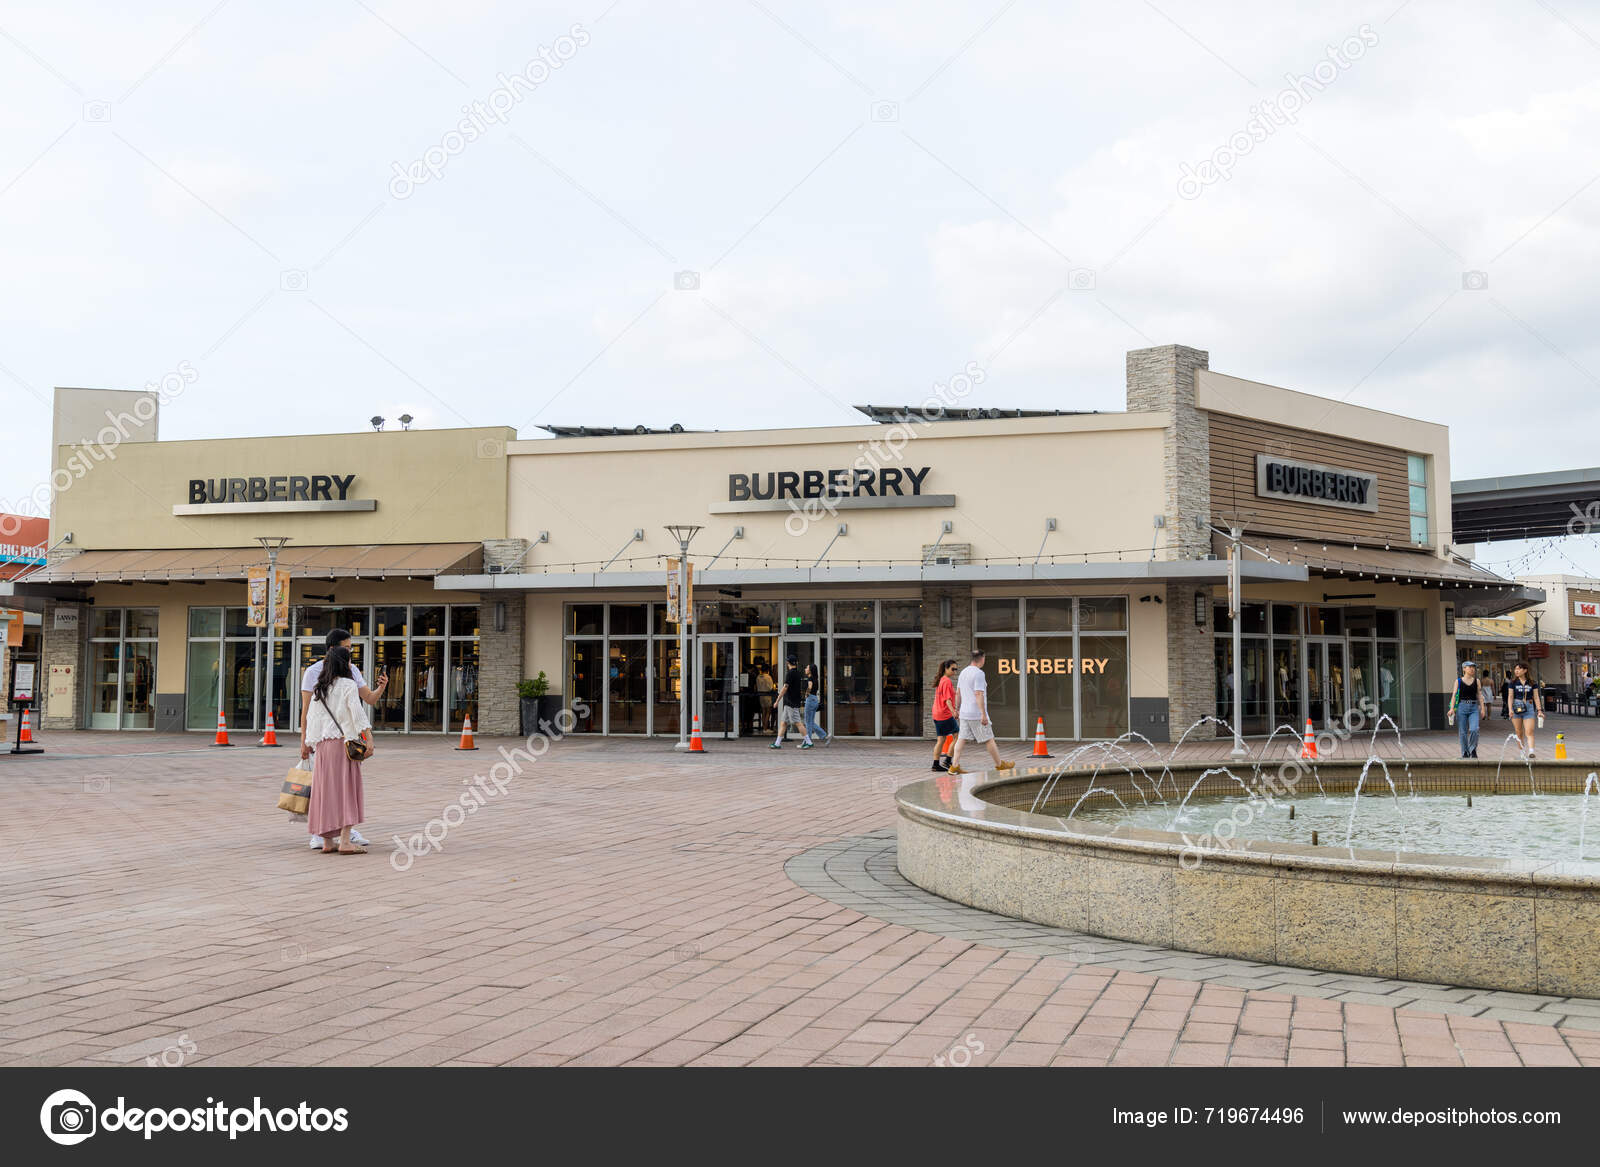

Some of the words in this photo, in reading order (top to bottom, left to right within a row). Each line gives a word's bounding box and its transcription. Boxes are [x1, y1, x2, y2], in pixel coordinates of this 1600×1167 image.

[188, 474, 356, 504] BURBERRY
[729, 467, 931, 501] BURBERRY
[1266, 462, 1371, 504] BURBERRY
